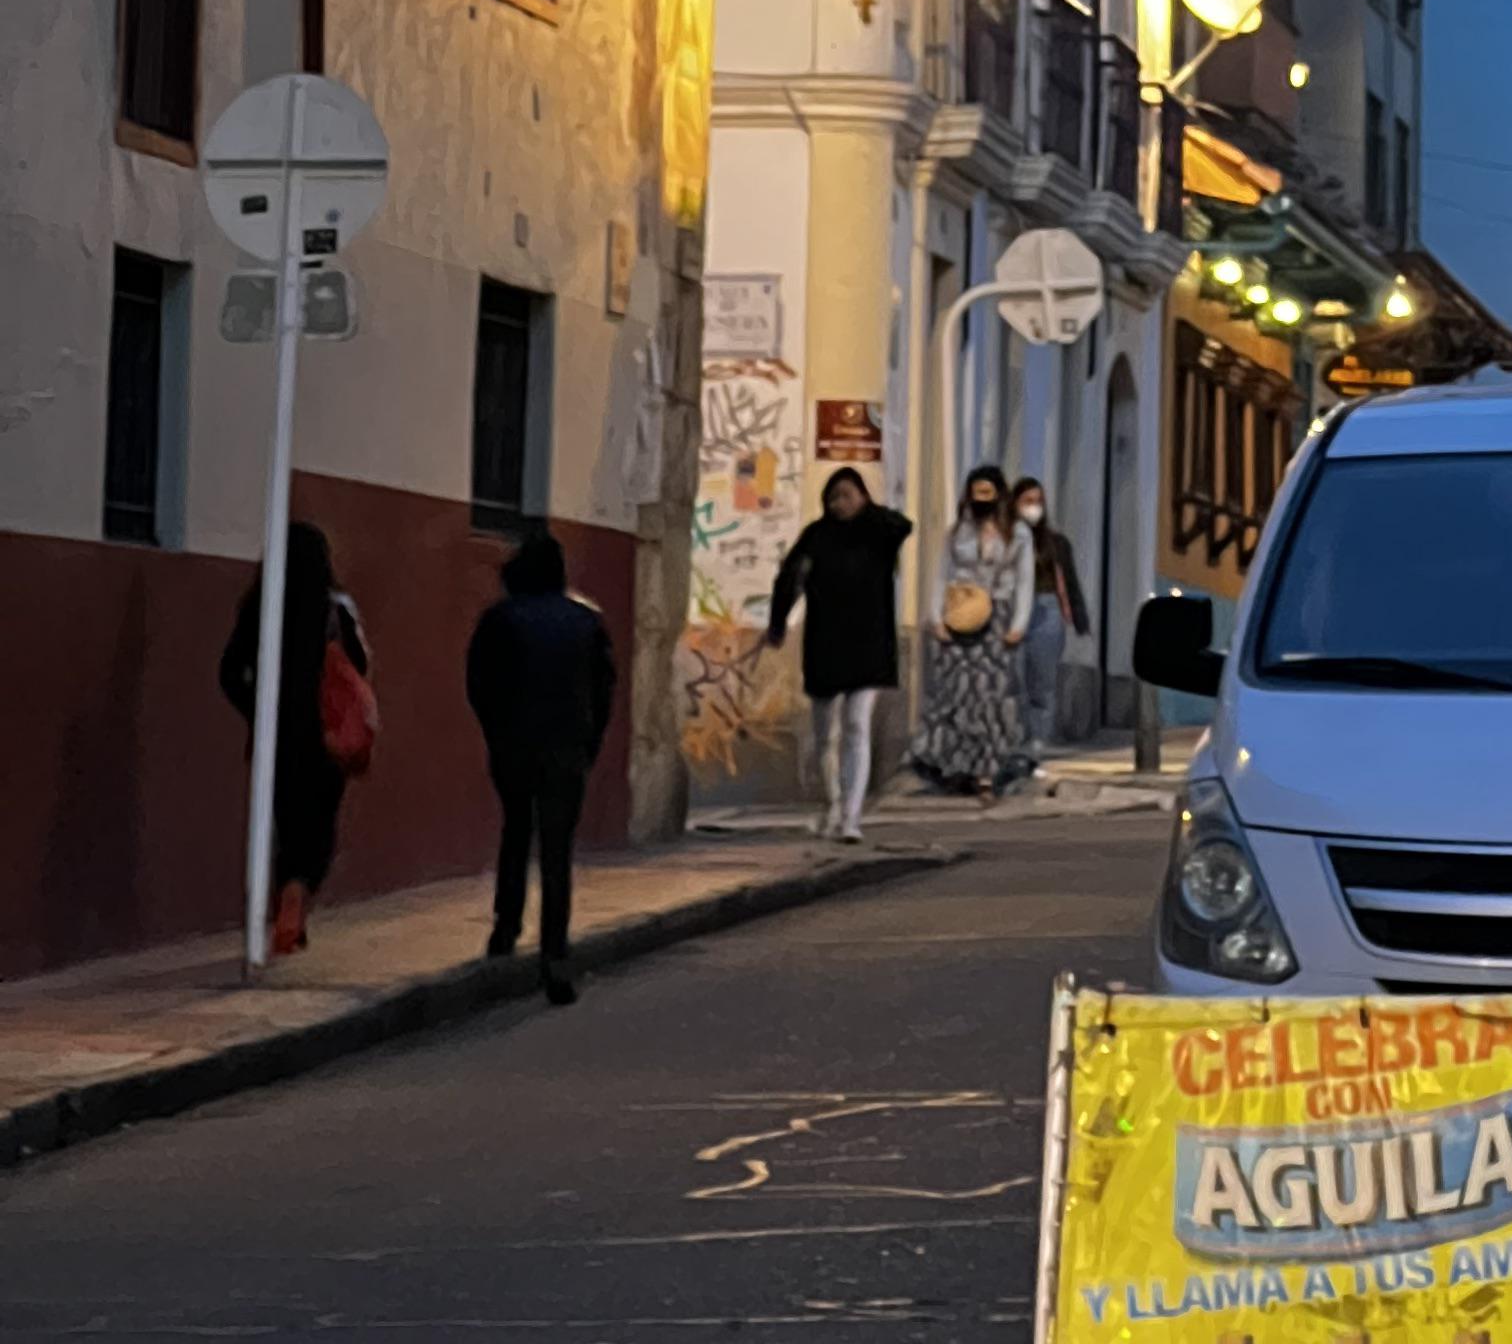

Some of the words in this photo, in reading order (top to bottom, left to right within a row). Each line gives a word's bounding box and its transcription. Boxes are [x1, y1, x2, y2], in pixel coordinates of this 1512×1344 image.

[1305, 1077, 1393, 1121] CON
[1082, 1285, 1111, 1323] Y
[1126, 1264, 1288, 1320] LLAMA
[1302, 1267, 1337, 1302] A
[1351, 1251, 1436, 1297] TUS
